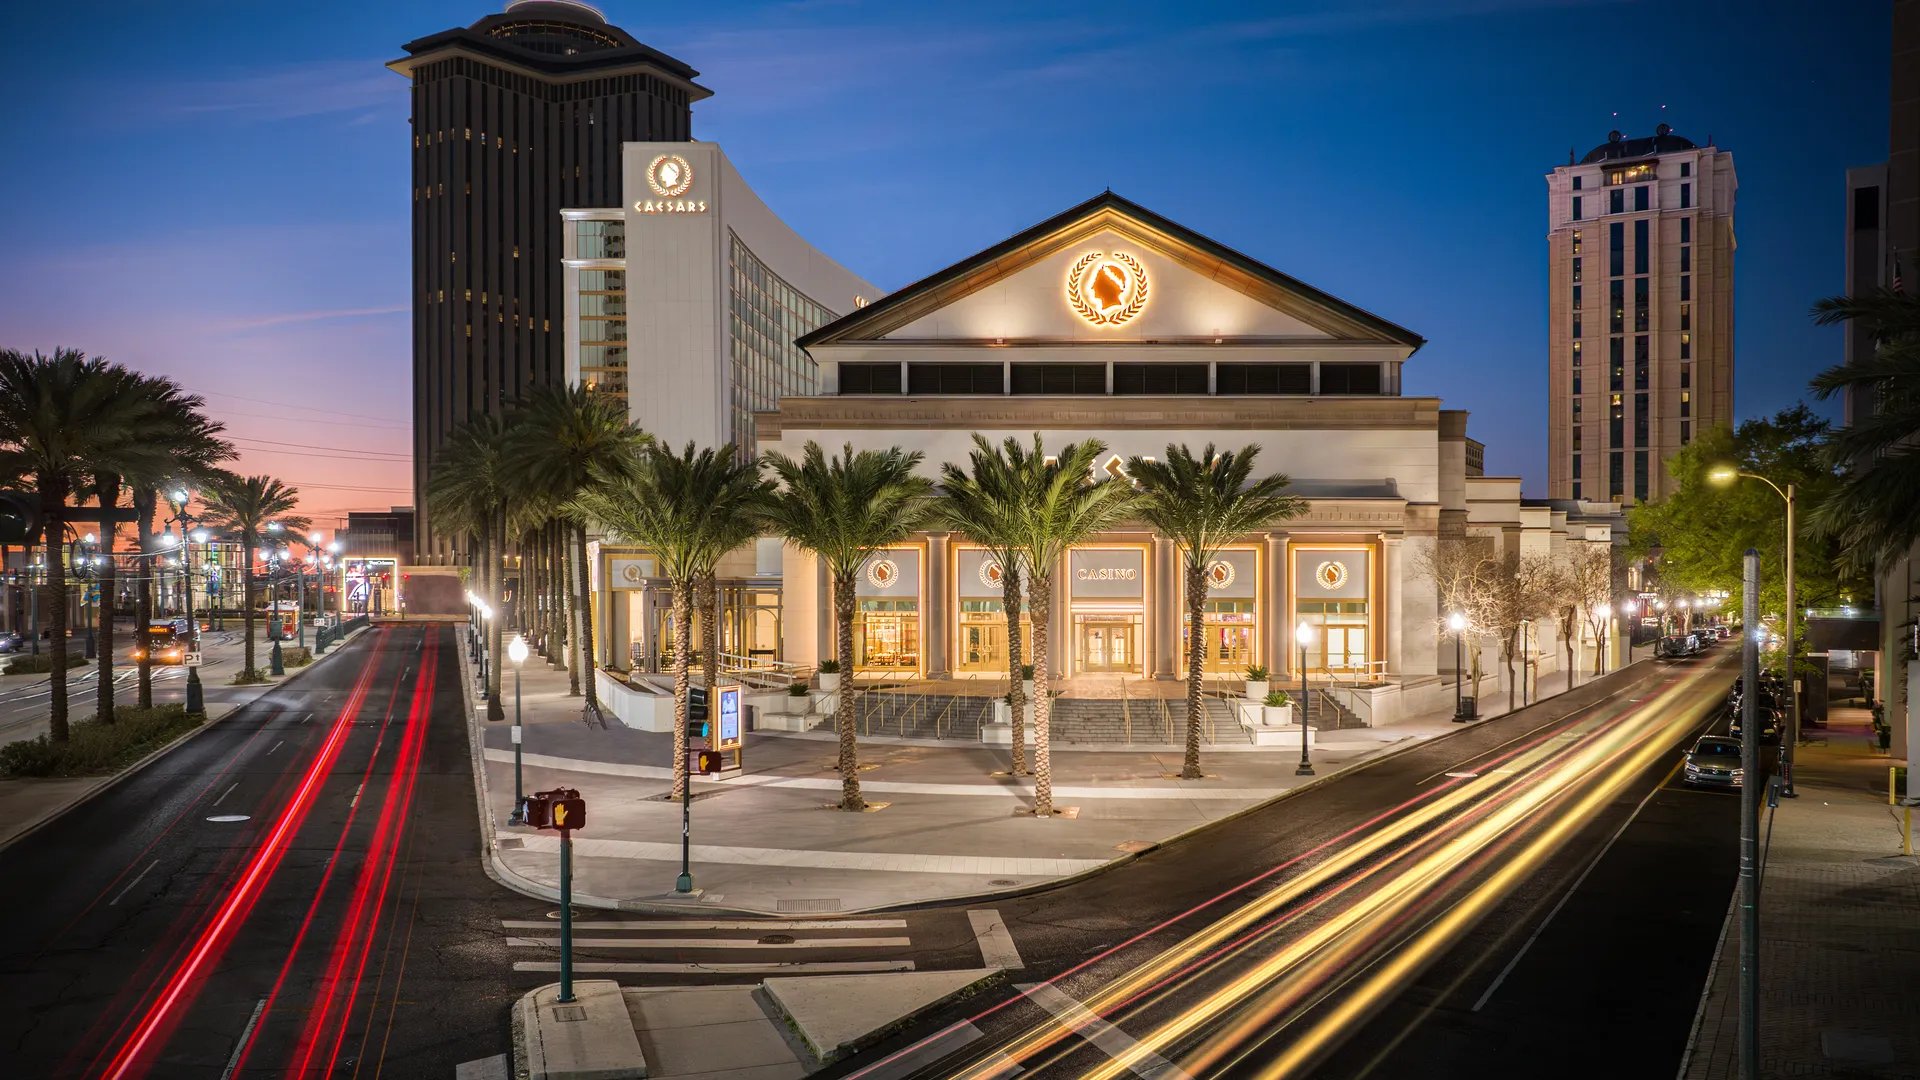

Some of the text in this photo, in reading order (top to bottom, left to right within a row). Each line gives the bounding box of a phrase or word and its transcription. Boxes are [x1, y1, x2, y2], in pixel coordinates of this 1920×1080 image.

[633, 200, 707, 213] CAESARS
[1076, 568, 1137, 581] CASINO
[184, 654, 194, 665] P
